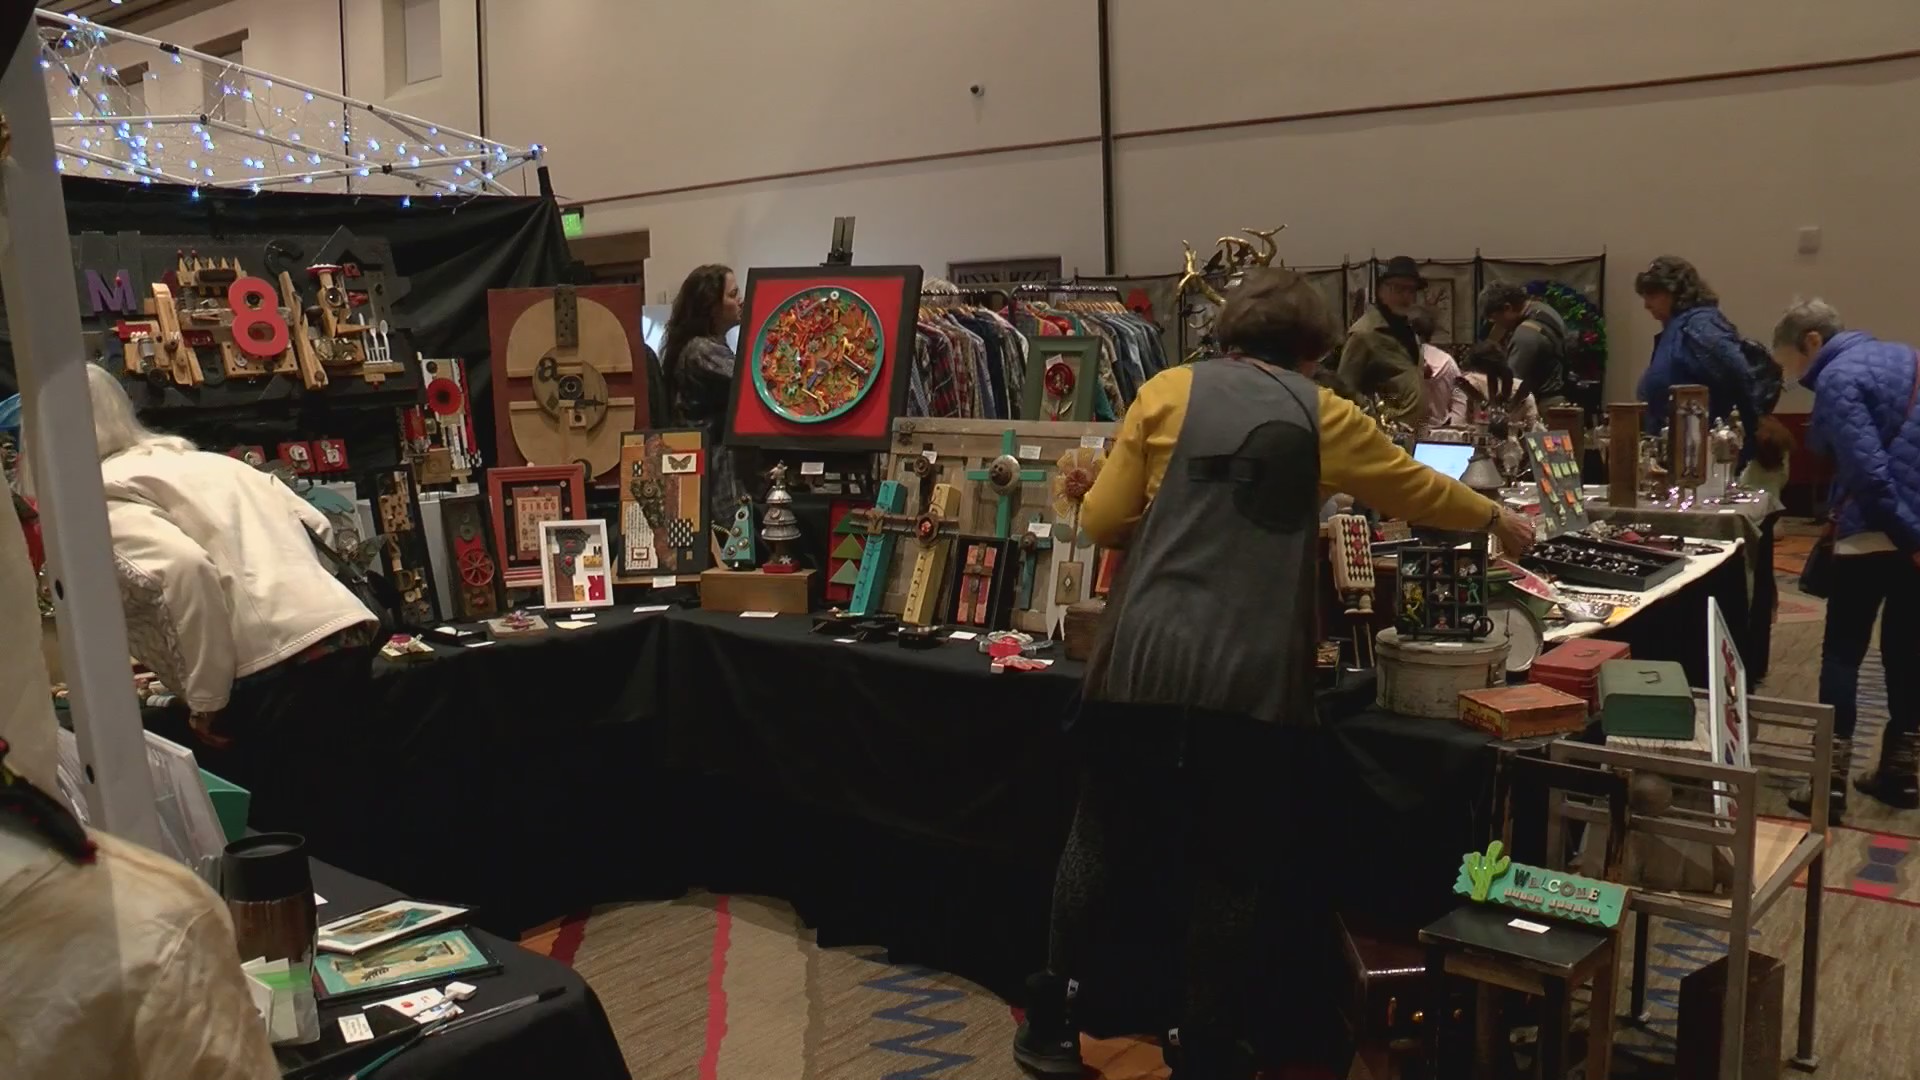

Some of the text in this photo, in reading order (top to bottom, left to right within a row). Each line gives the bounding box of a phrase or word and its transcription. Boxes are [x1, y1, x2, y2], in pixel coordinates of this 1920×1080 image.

[85, 268, 137, 313] M
[228, 276, 288, 358] 8
[539, 357, 561, 383] a
[521, 502, 556, 512] BINGO
[1514, 869, 1600, 901] WELCOME
